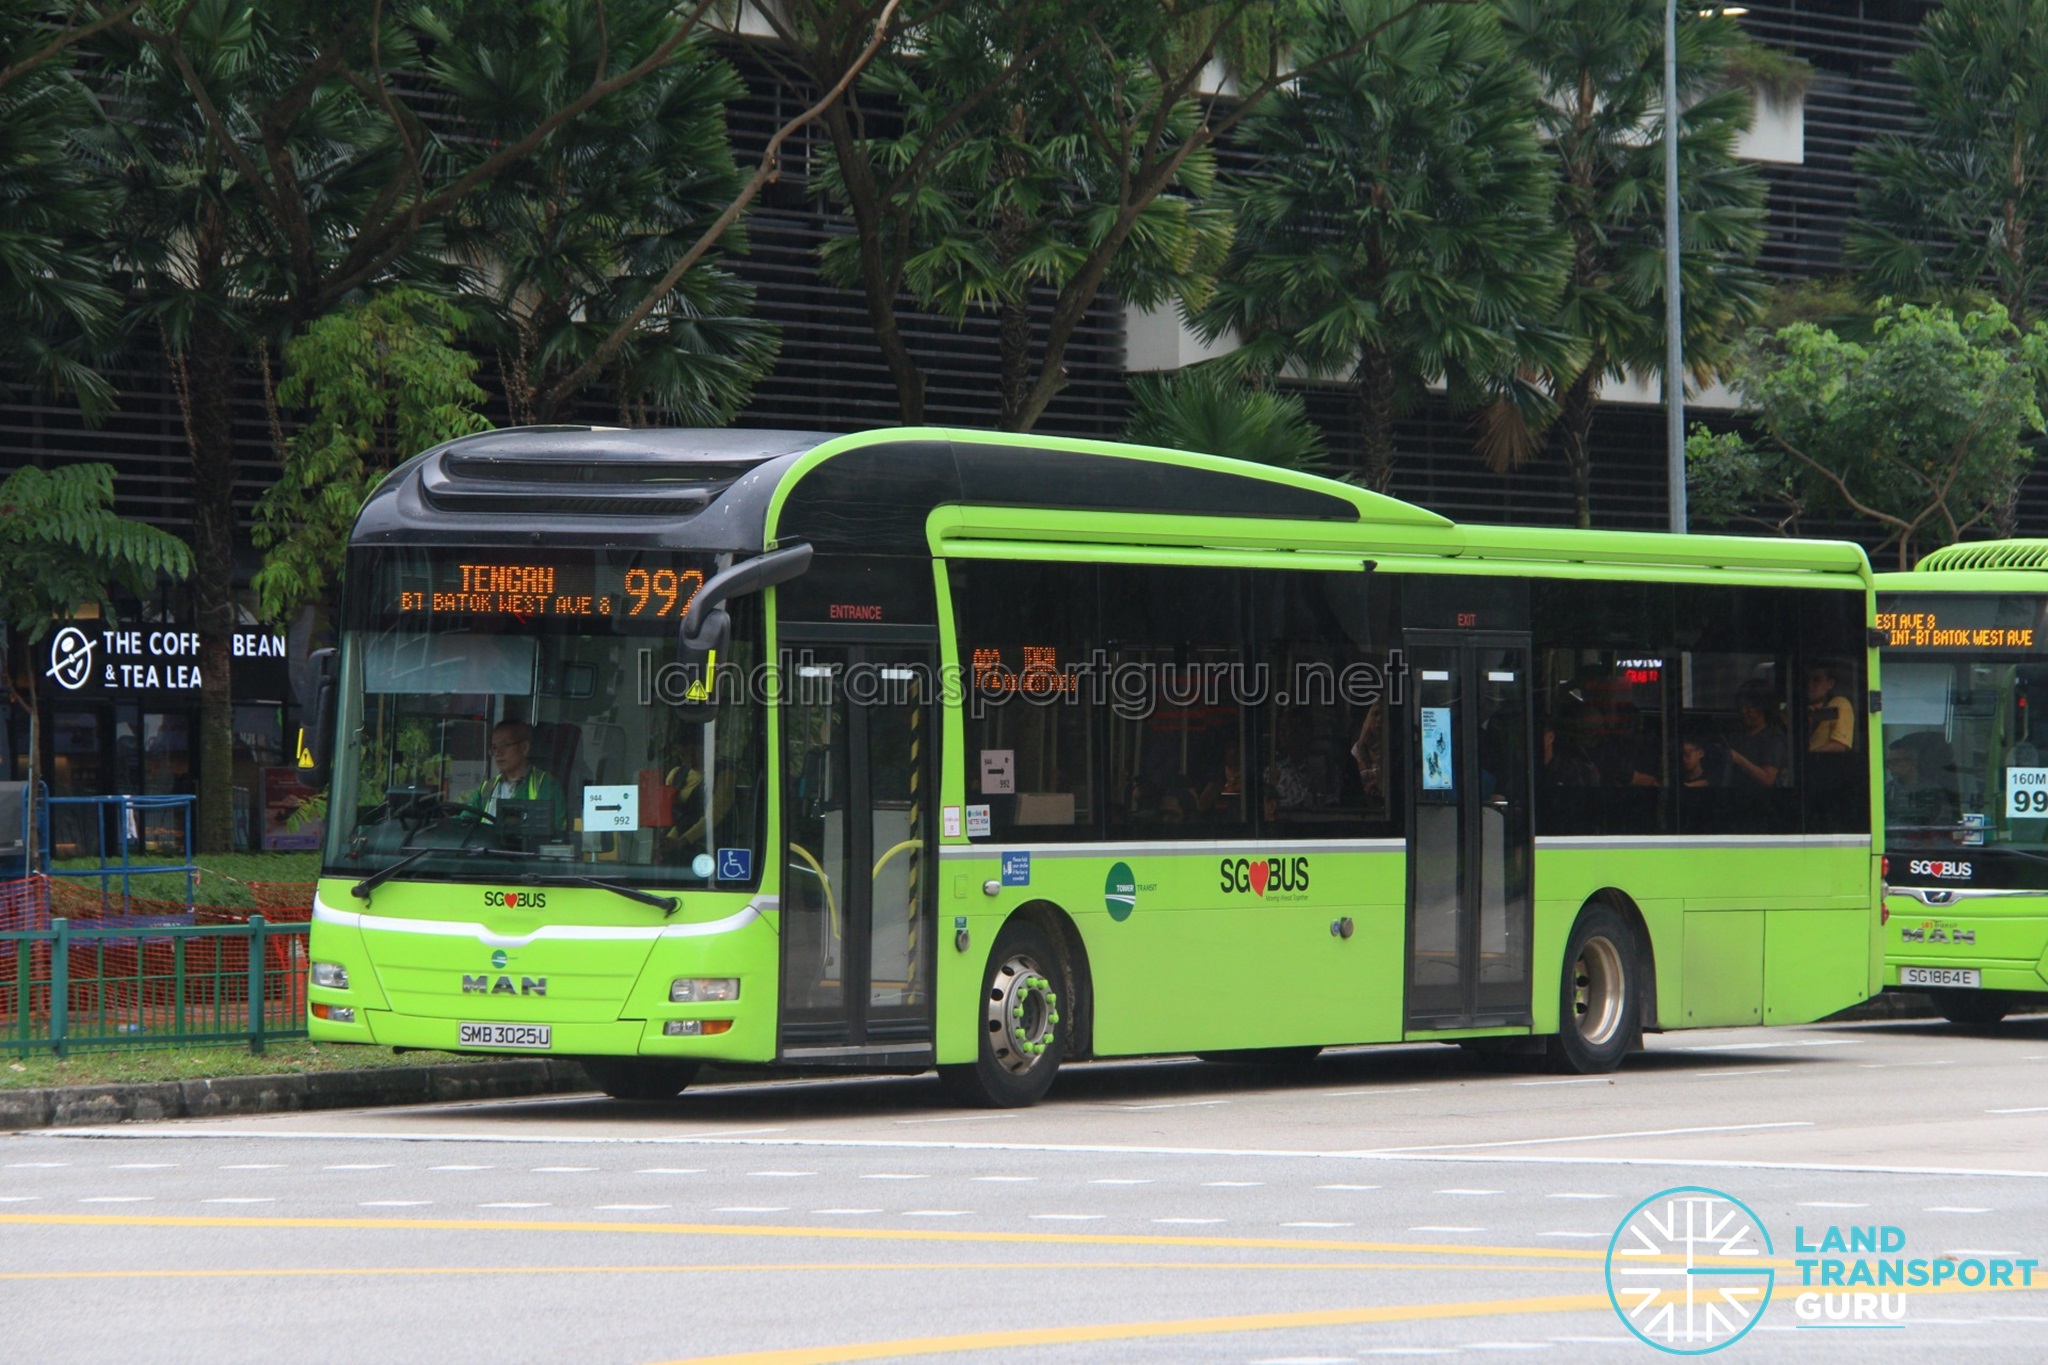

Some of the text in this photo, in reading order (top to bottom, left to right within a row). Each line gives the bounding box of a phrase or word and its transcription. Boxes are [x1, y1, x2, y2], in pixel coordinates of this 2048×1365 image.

[459, 565, 554, 593] TENGAH
[402, 592, 610, 615] BT BATOK WEST AVE 8
[830, 604, 882, 620] ENTRANCE
[1457, 613, 1477, 627] EXIT
[1875, 614, 1936, 630] EST AVE 8
[103, 631, 286, 658] THE COFF BEAN
[1890, 630, 2033, 646] INT-BT BATOK WEST AVE
[105, 664, 202, 688] & TEA LEA
[2012, 773, 2047, 785] 160M
[589, 794, 603, 802] 944
[613, 816, 631, 826] 992
[1220, 857, 1310, 894] SG BUS
[1909, 860, 1972, 876] SG BUS
[1116, 884, 1157, 893] TOWER TRANSIT
[484, 891, 546, 908] SG BUS
[1902, 928, 1975, 945] MAN
[1909, 969, 1972, 984] SG1864E
[462, 975, 548, 996] MAN
